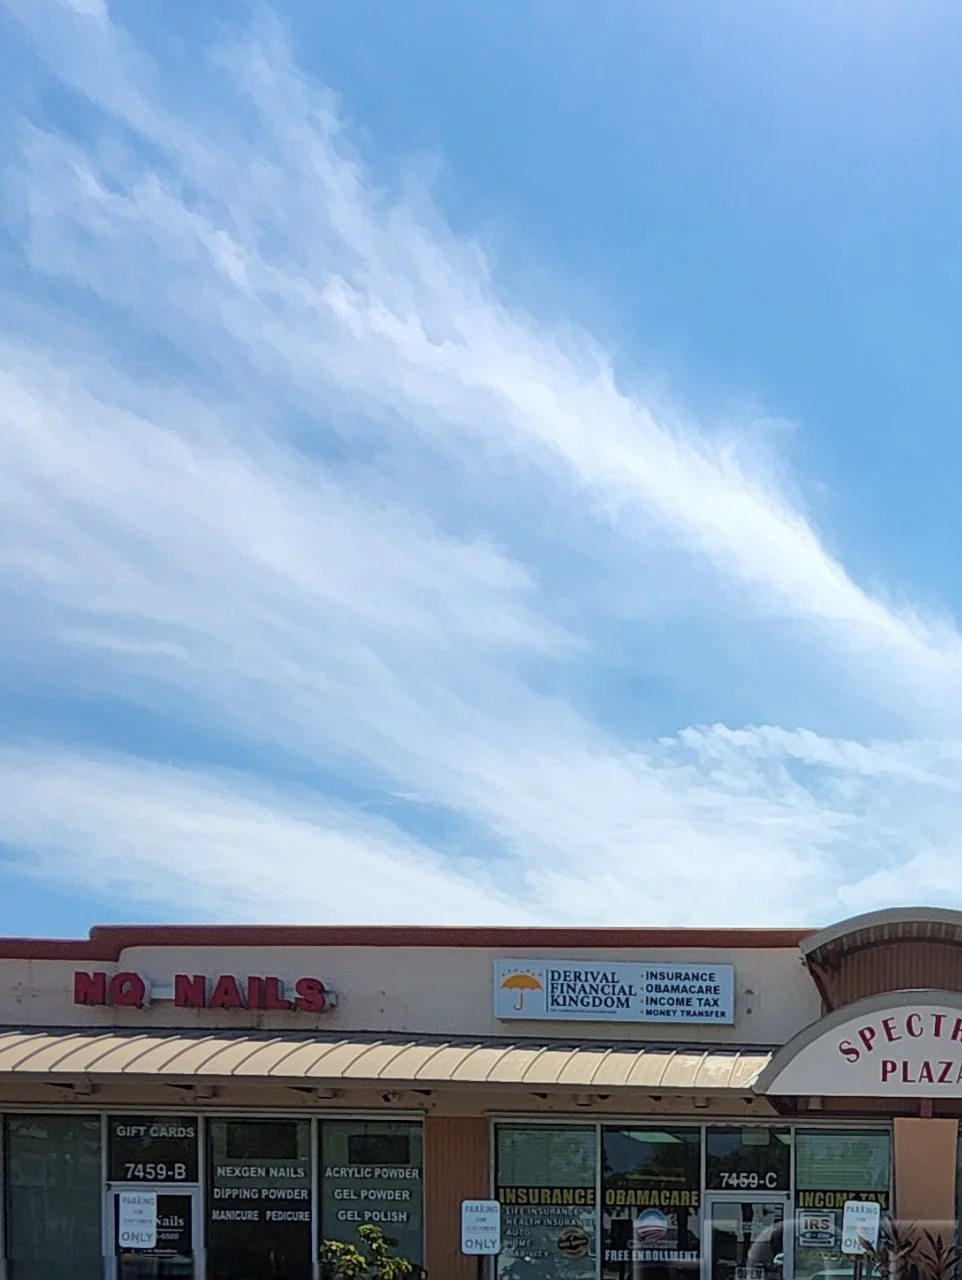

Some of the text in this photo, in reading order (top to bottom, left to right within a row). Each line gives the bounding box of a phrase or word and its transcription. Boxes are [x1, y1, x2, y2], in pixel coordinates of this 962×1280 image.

[550, 970, 620, 983] DERIVAL
[645, 971, 716, 982] INSURANCE
[74, 971, 327, 1013] NQ NAILS
[550, 983, 637, 997] FINANCIAL
[645, 984, 721, 995] OBAMACARE
[550, 995, 631, 1009] KINGDOM
[645, 996, 720, 1008] INCOME TAX
[645, 1009, 727, 1018] MONEY TRANSFER
[116, 1126, 195, 1138] GIFT CARDS
[125, 1163, 187, 1179] 7459-B
[217, 1167, 305, 1178] NEXGEN NAILS
[325, 1168, 420, 1179] ACRYLIC POWDER
[720, 1172, 777, 1188] 7459-C
[213, 1188, 308, 1200] DIPPING POWDER
[334, 1189, 411, 1200] GEL POWDER
[499, 1188, 595, 1204] INSURANCE
[605, 1188, 699, 1206] OBAMACARE
[464, 1205, 498, 1213] PARKING
[528, 1208, 578, 1216] INSURANCE
[846, 1205, 878, 1215] PARKING
[212, 1210, 310, 1221] MANICURE PEDICURE
[337, 1210, 407, 1222] GEL POLISH
[543, 1218, 591, 1226] INSURAN
[804, 1218, 831, 1230] IRS
[121, 1232, 154, 1243] ONLY
[465, 1239, 498, 1249] ONLY
[844, 1238, 875, 1249] ONY
[605, 1250, 629, 1261] FREE
